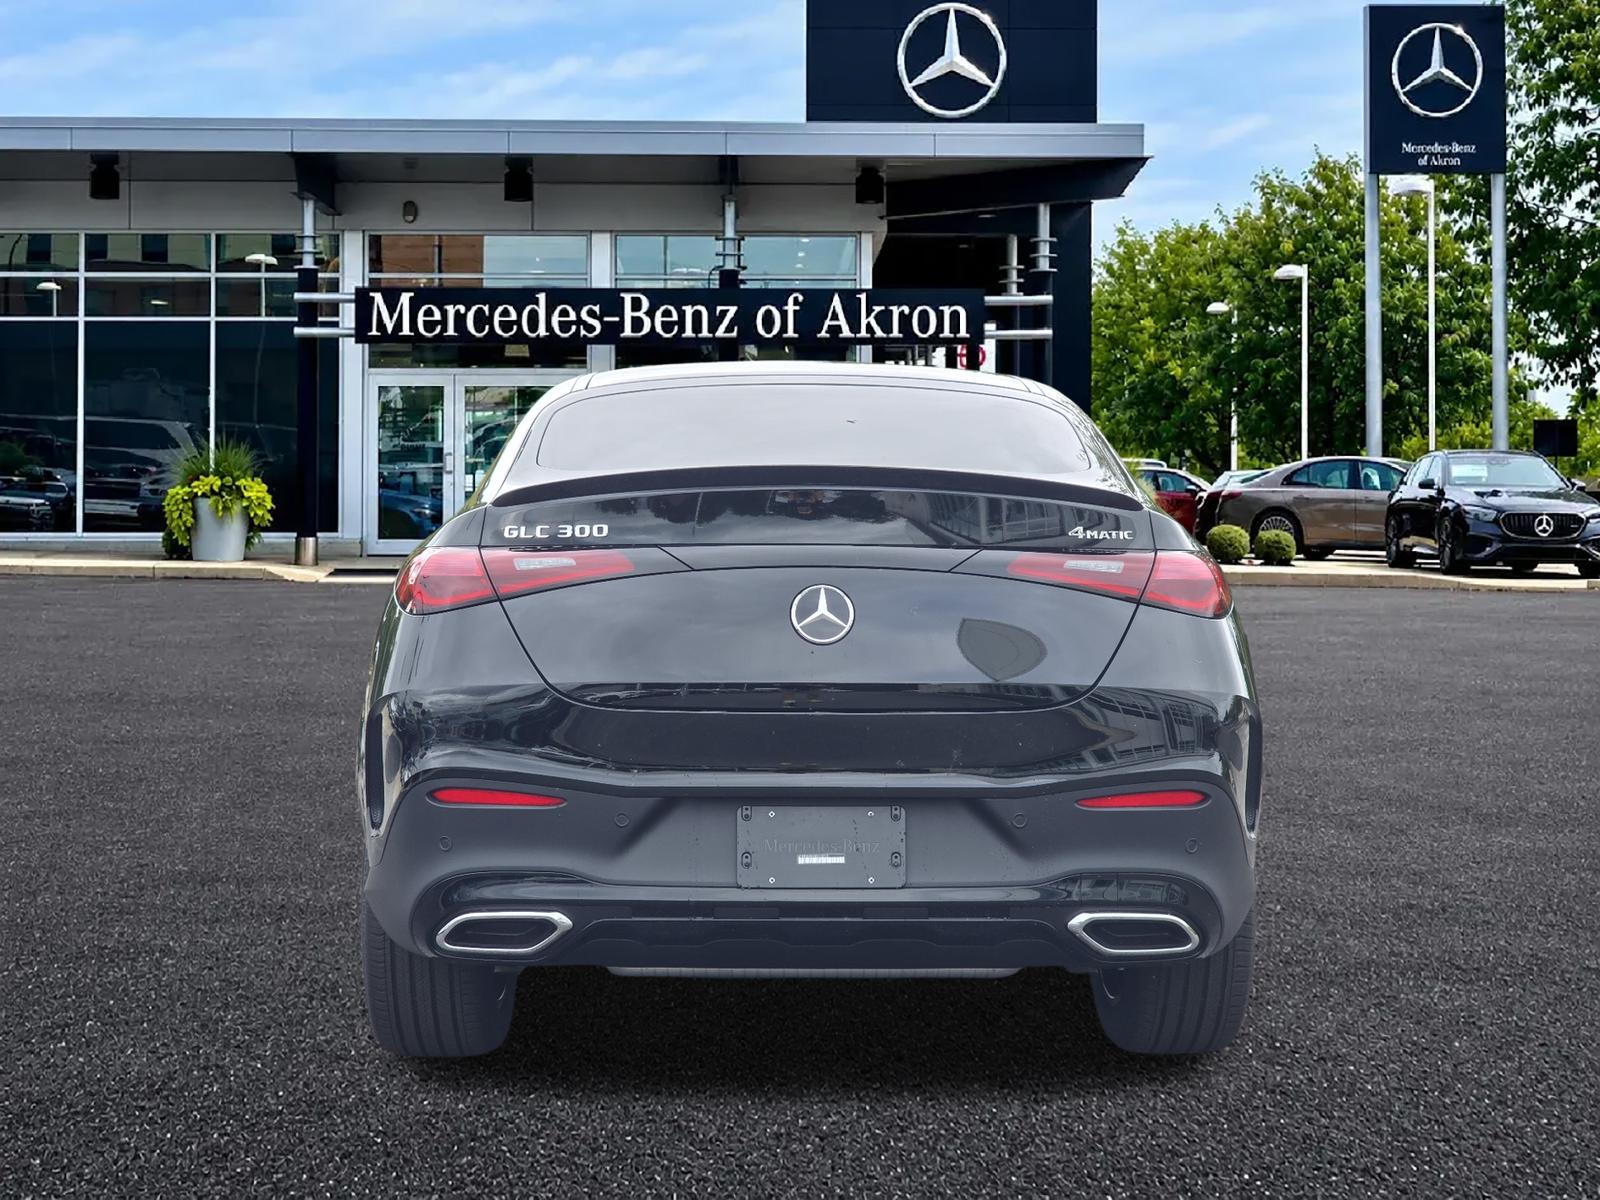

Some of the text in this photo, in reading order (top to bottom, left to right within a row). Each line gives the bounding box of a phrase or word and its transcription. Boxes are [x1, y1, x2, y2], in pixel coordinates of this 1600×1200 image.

[1401, 142, 1476, 153] Mercedes-Benz
[1430, 155, 1461, 166] Akron
[368, 292, 970, 339] Mercedes-Benz of Akron
[503, 524, 609, 538] GLC 300
[1068, 526, 1134, 540] 4MATIC
